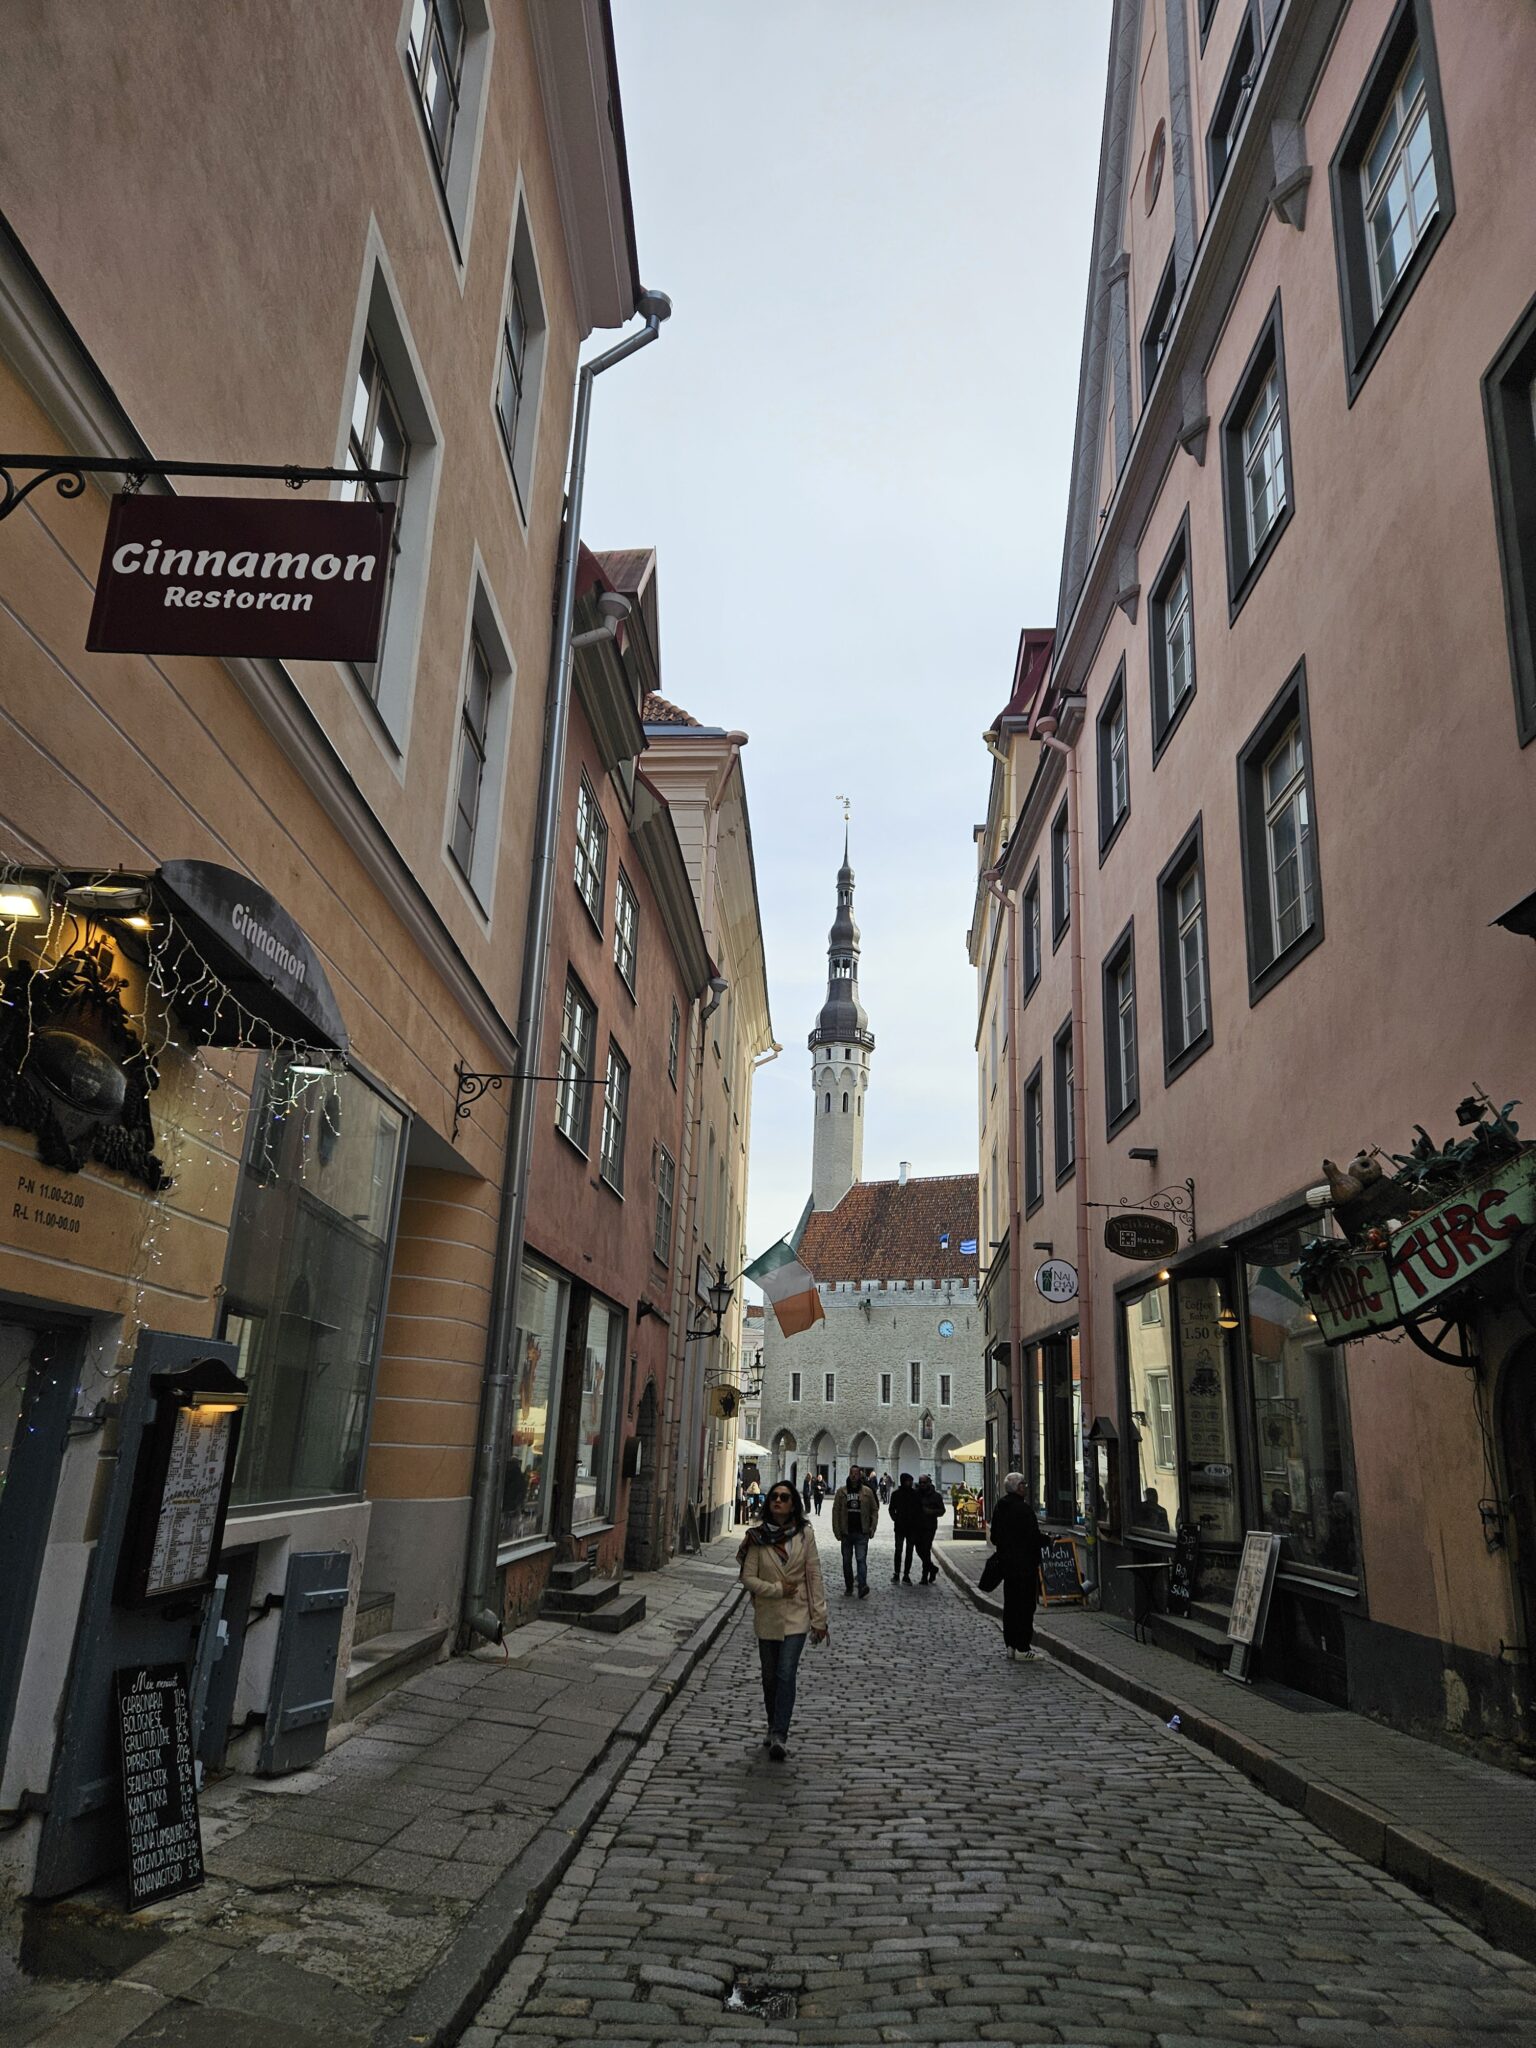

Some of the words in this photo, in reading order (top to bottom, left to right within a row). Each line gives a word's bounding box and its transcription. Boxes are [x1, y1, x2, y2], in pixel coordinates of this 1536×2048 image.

[112, 538, 376, 582] Cinnamon
[163, 586, 313, 612] Restoran
[232, 903, 306, 983] Cinnamon
[17, 1176, 35, 1194] P-N
[40, 1183, 84, 1208] 11.00-23.00
[13, 1203, 29, 1220] R-L
[35, 1209, 80, 1233] 11.00-00.00
[1391, 1189, 1521, 1299] TURG
[1053, 1281, 1074, 1289] CHAI
[1054, 1270, 1070, 1281] NAI
[1185, 1299, 1214, 1312] Coffee
[1185, 1328, 1209, 1340] 1.50
[1041, 1546, 1069, 1560] Mochi
[122, 1691, 163, 1715] CARBONARA
[123, 1710, 162, 1734] BOLOGNESE
[127, 1795, 147, 1816] KANA
[147, 1788, 168, 1810] TIKKA
